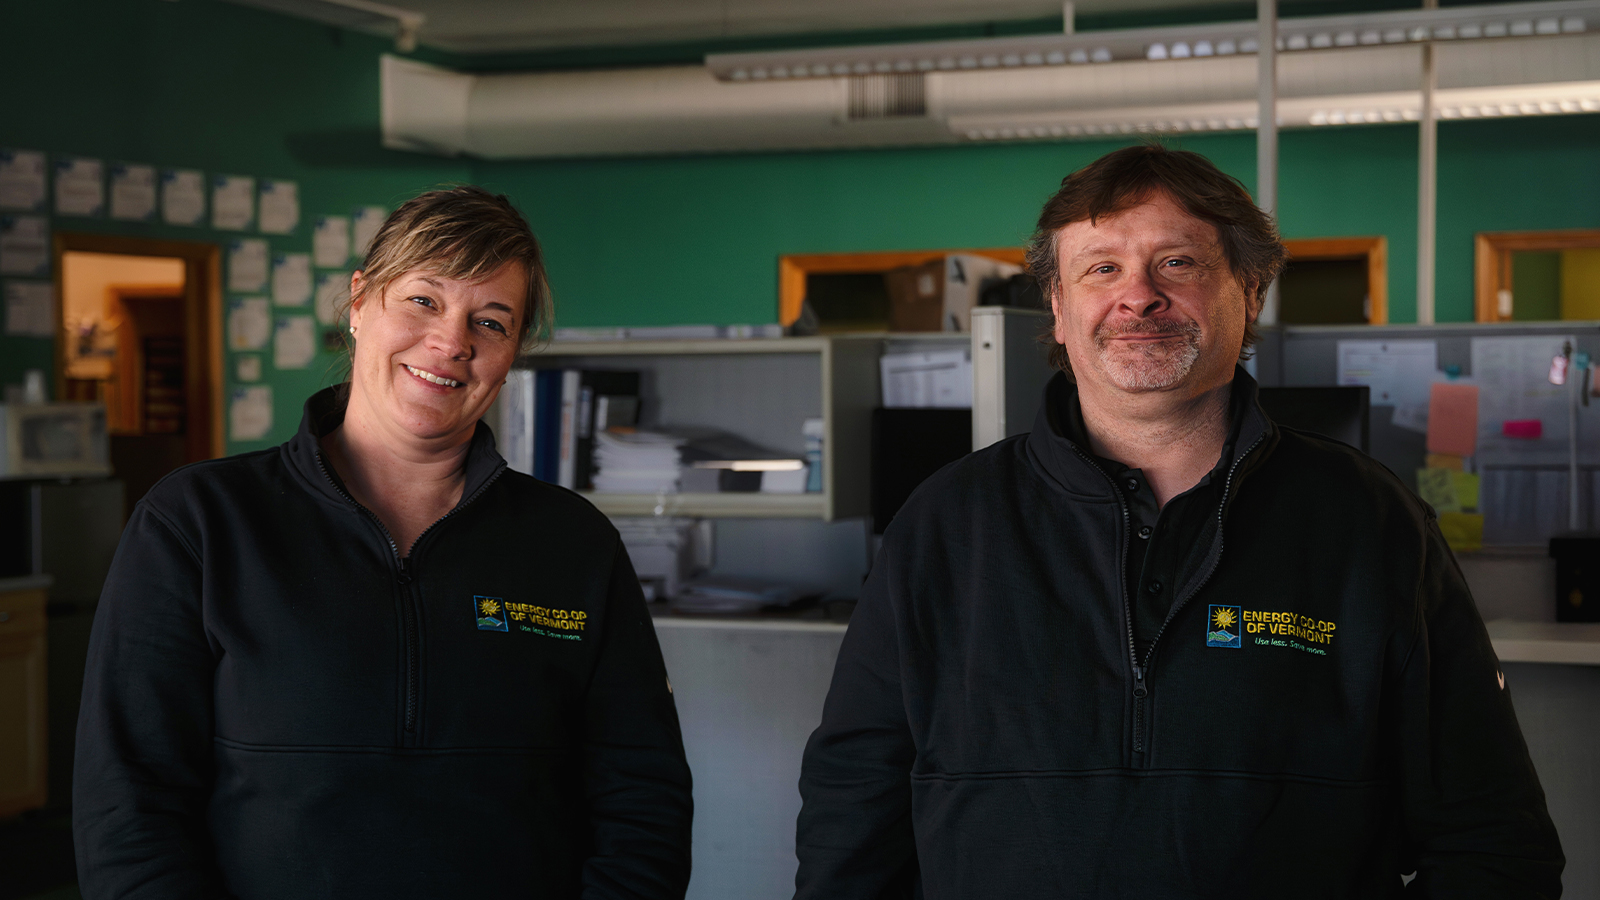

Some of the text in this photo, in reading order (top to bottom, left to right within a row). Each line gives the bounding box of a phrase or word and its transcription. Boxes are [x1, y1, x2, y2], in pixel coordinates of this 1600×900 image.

[505, 601, 587, 621] ENERGY CO-OP
[510, 611, 586, 631] OF VERMONT
[1243, 610, 1336, 633] ENERGY CO-OP
[1246, 622, 1334, 644] OF VERMONT
[1254, 637, 1327, 656] Use less. Save more.
